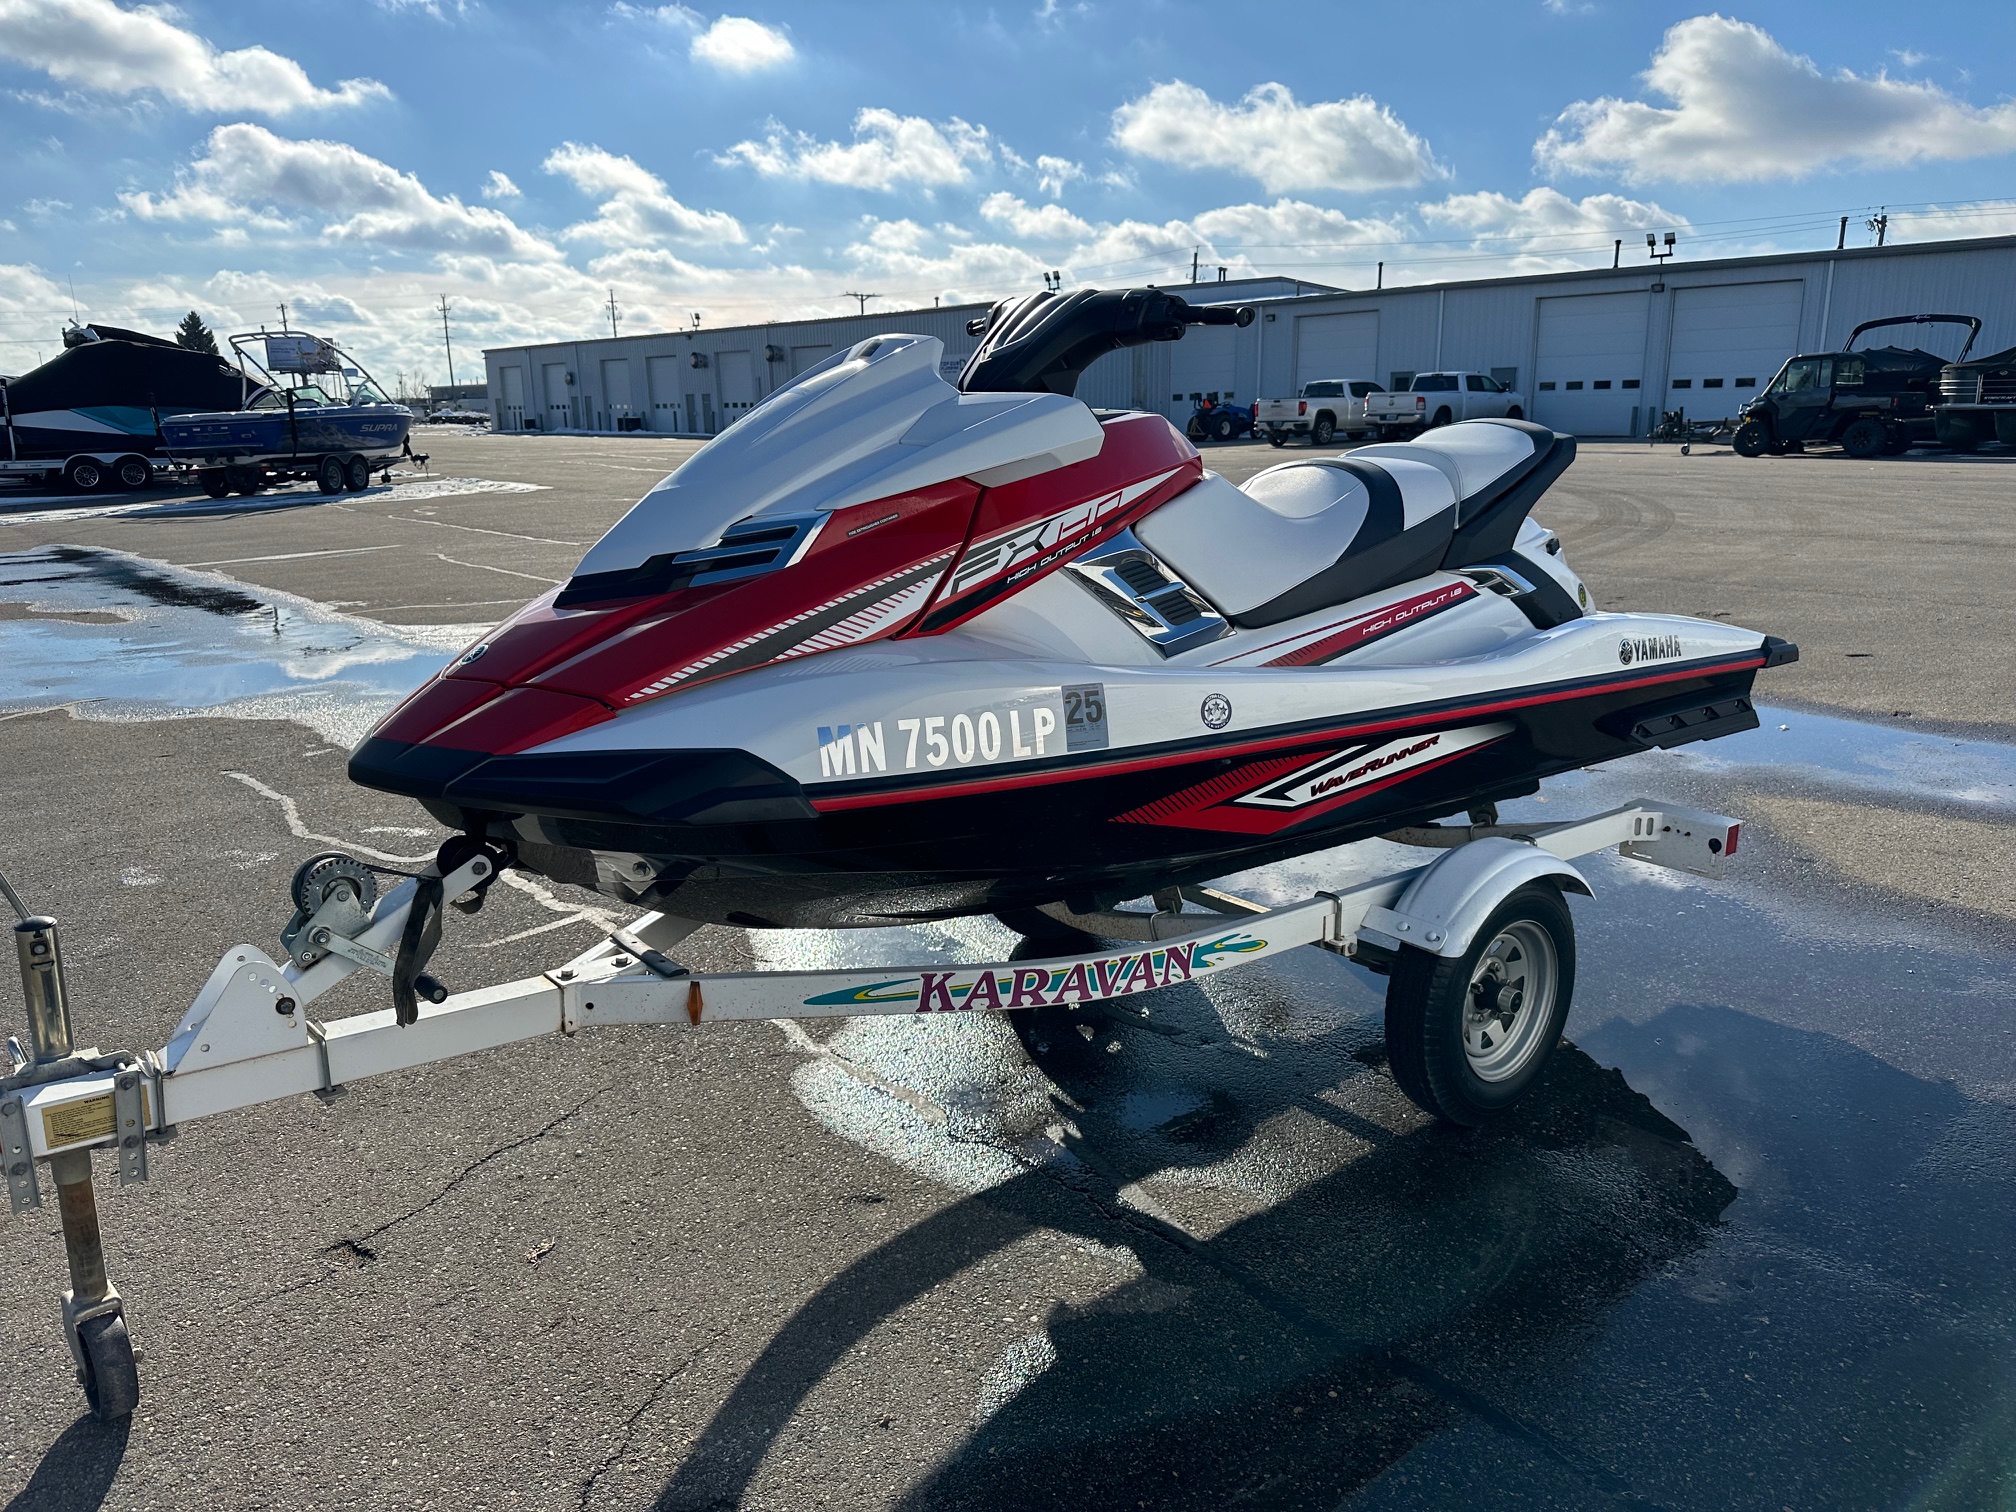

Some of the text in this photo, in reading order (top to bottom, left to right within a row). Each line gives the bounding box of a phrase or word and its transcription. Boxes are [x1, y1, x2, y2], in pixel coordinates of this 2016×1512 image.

[360, 423, 398, 432] SUPRA
[1007, 563, 1037, 584] HIGH
[1040, 534, 1089, 566] OUTPUT
[1362, 617, 1392, 635] HIGH
[1395, 594, 1447, 621] OUTPUT
[1633, 635, 1682, 661] YAMAHA
[1065, 690, 1102, 724] 25
[817, 707, 1055, 777] MN 7500 LP
[915, 942, 1198, 1013] KARAVAN
[84, 1095, 110, 1104] WARNING
